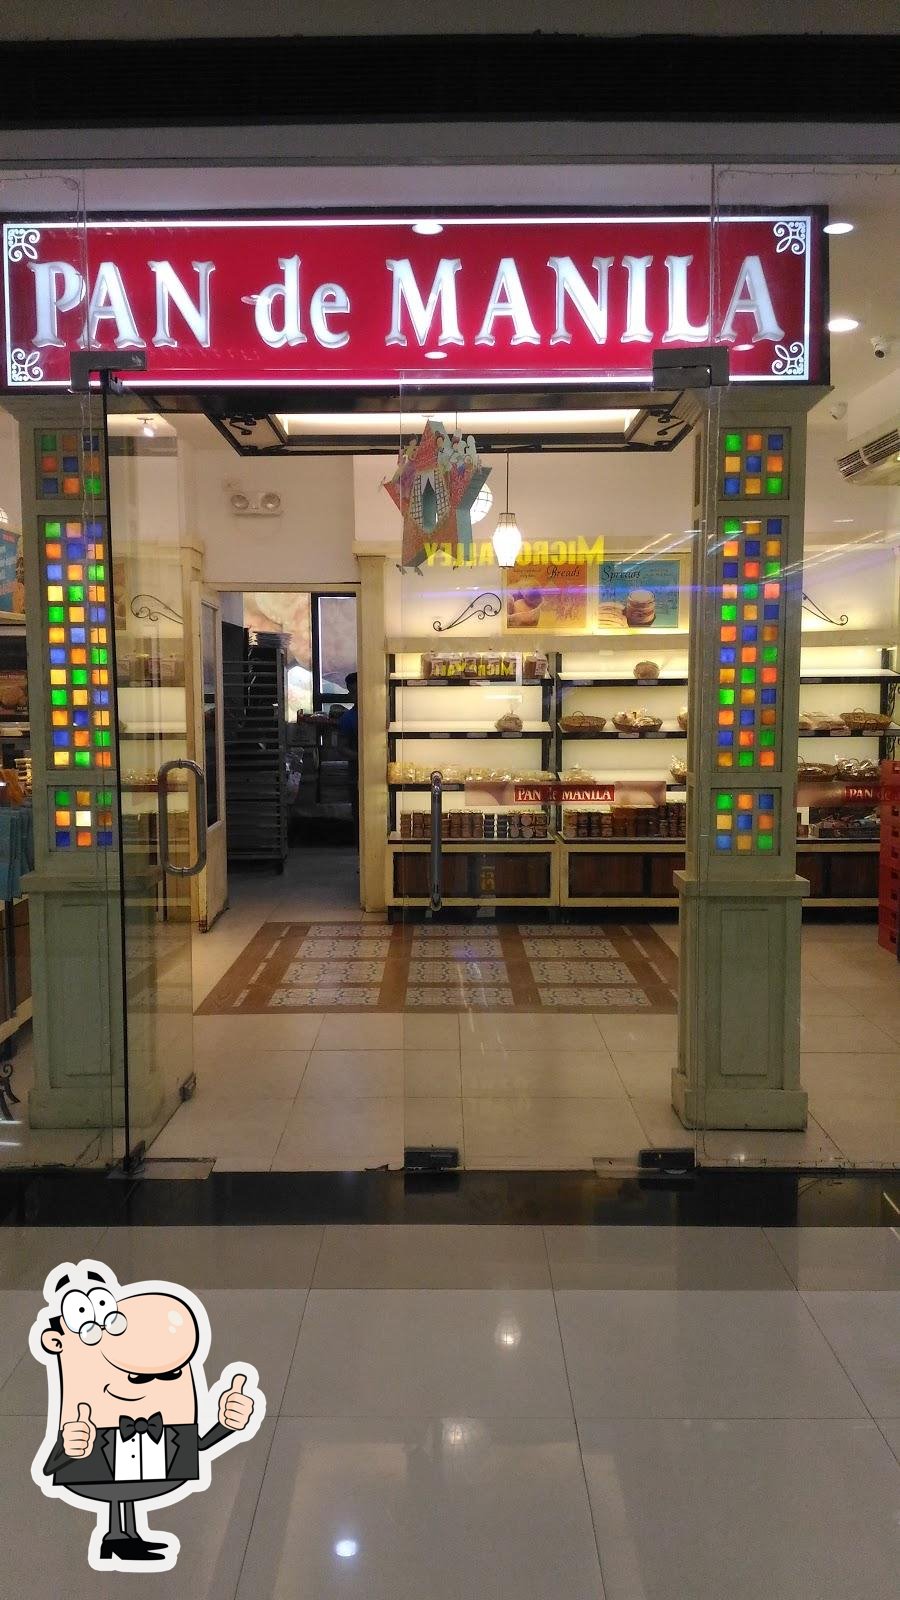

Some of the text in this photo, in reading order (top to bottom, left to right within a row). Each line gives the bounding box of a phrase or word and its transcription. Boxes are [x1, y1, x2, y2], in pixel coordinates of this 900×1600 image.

[27, 253, 786, 349] PAN de MANILA
[546, 565, 581, 579] Breads
[517, 789, 542, 801] PAN
[562, 789, 612, 801] MANILA
[849, 788, 873, 799] PAN
